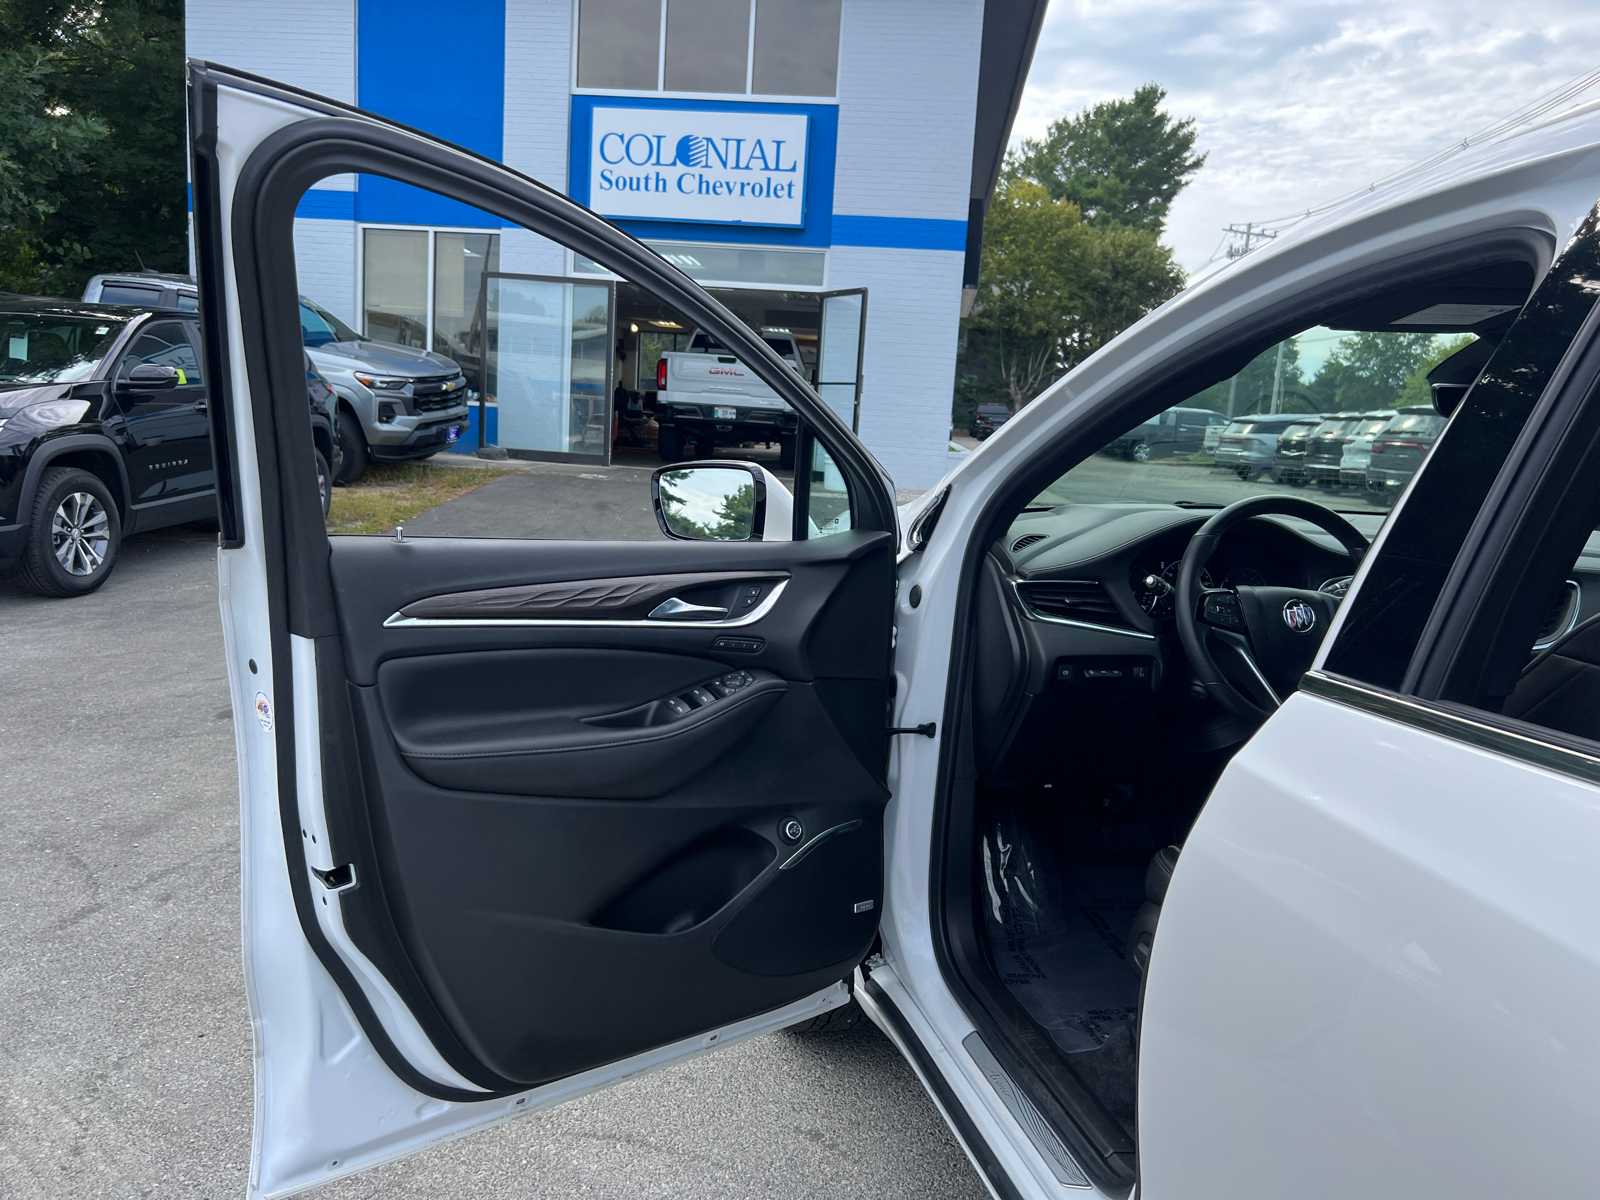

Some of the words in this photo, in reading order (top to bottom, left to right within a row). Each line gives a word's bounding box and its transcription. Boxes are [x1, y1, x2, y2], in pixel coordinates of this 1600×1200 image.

[600, 132, 797, 172] COLONIAL
[599, 168, 668, 193] South
[676, 172, 796, 199] Chevrolet
[709, 367, 745, 376] GMC
[149, 459, 189, 470] EQUINOX
[1012, 906, 1025, 935] COVER
